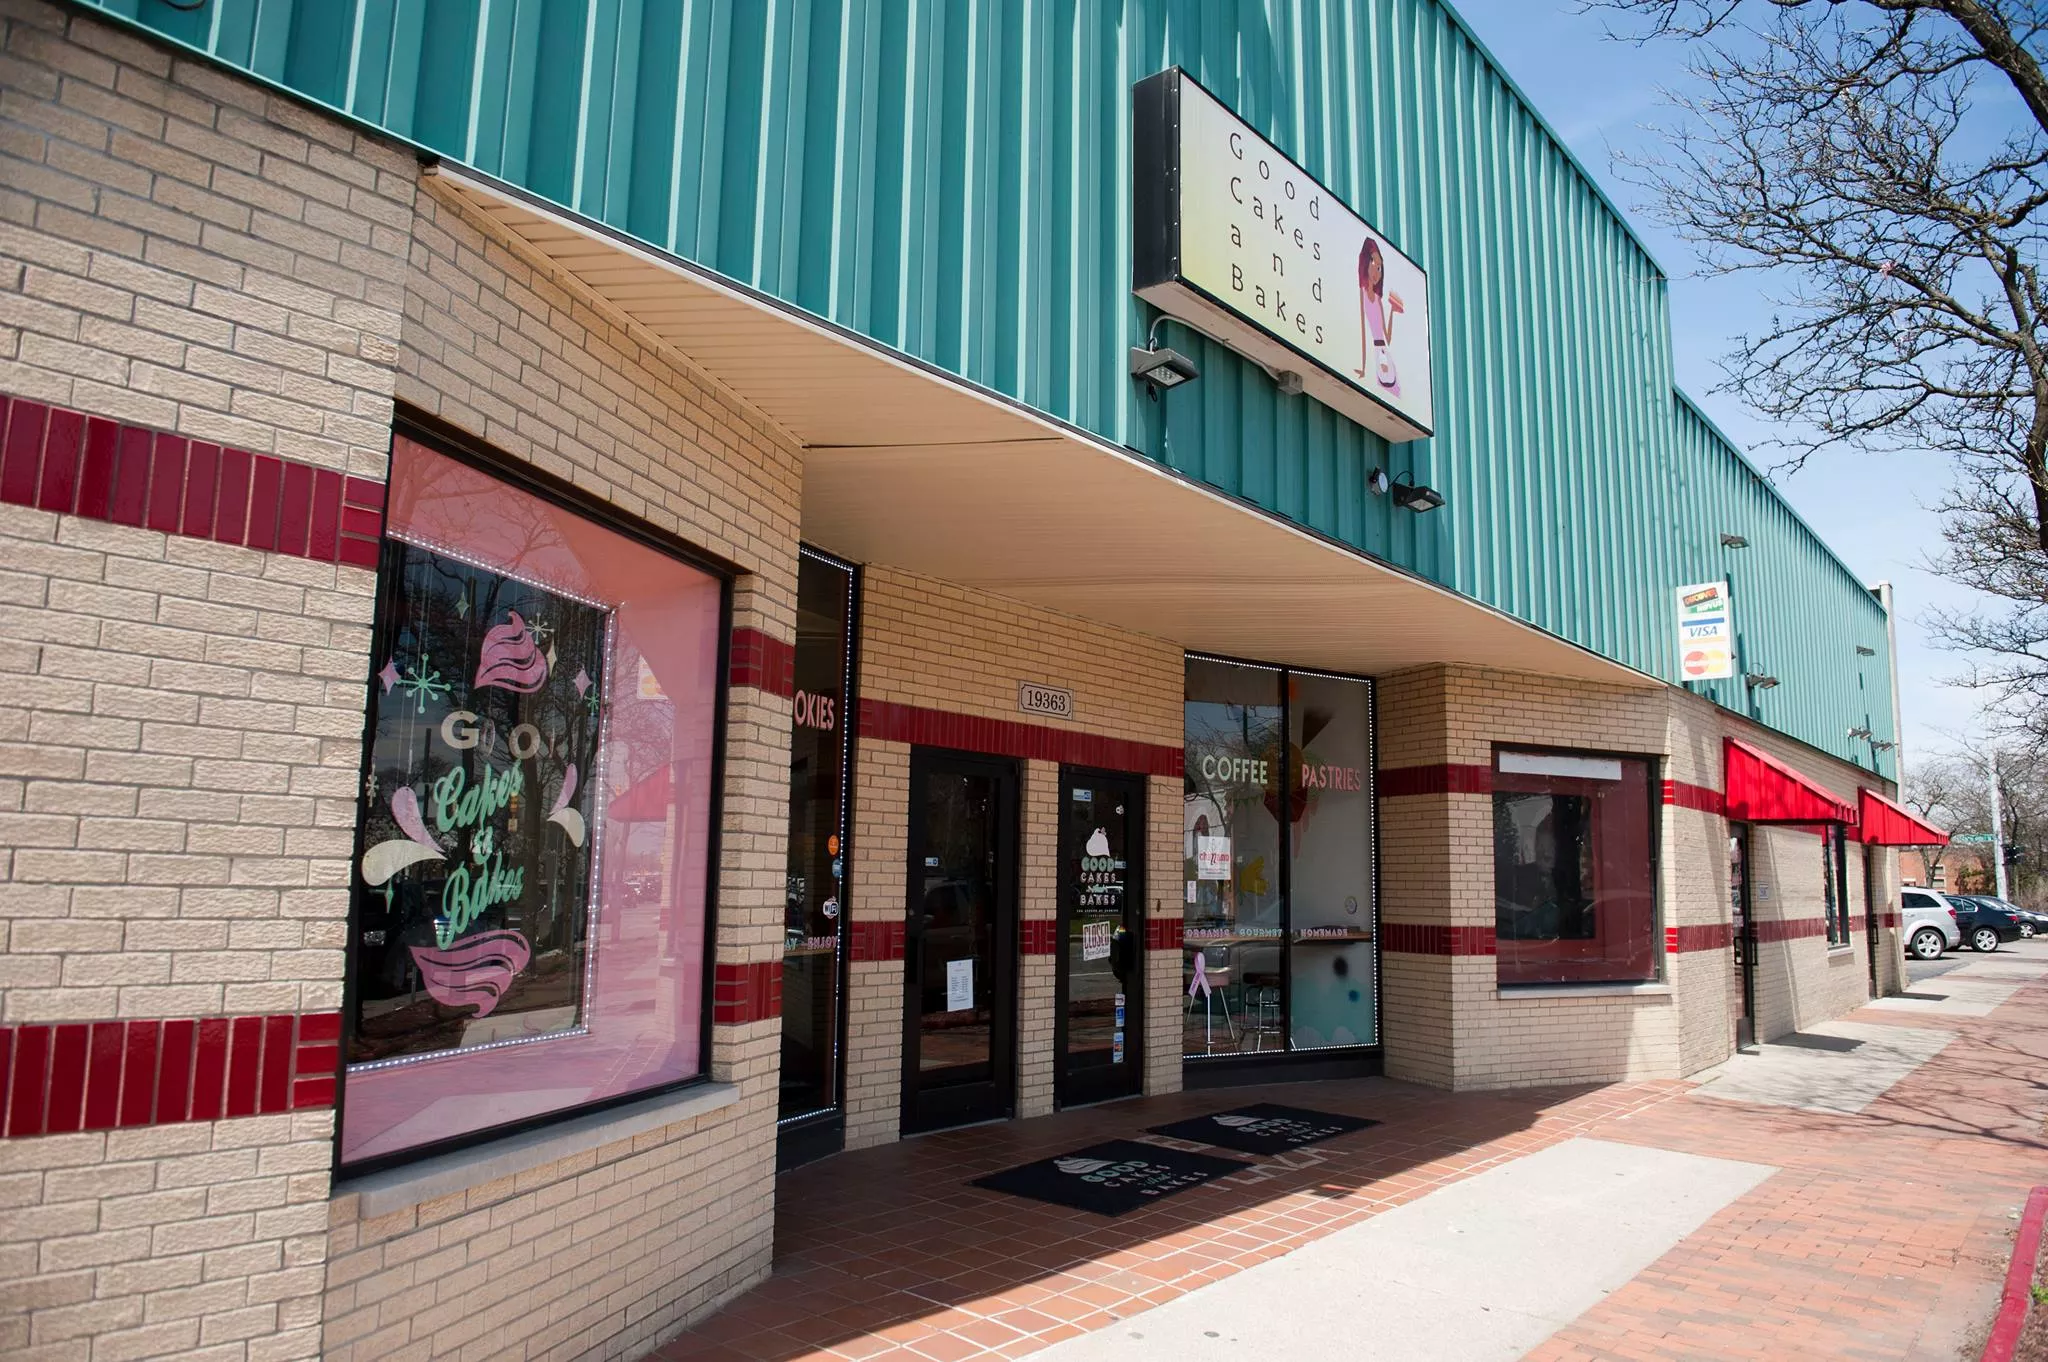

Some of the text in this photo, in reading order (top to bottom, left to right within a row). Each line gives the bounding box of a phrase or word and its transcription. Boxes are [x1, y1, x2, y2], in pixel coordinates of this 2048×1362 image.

[1230, 132, 1320, 221] Good
[1230, 177, 1321, 261] Cakes
[1231, 224, 1322, 303] and
[1231, 264, 1323, 344] Bakes
[1689, 626, 1718, 637] VISA
[1027, 689, 1066, 712] 19363
[1202, 755, 1268, 785] COFFEE
[1302, 763, 1361, 791] PASTRIES
[433, 758, 523, 833] Cakes
[1081, 857, 1115, 872] GOOD
[1080, 872, 1116, 883] CAKES
[435, 848, 524, 950] Bakes
[1080, 894, 1116, 906] BAKES
[807, 935, 838, 950] ENJOY
[1084, 924, 1109, 949] CLOSED
[1186, 928, 1348, 938] ORGANIC GOURMET HOMEMADE
[1237, 1118, 1292, 1133] GOOD
[1081, 1160, 1149, 1183] GOOD
[1103, 1164, 1171, 1188] CAKES
[1140, 1171, 1208, 1196] BAKES
